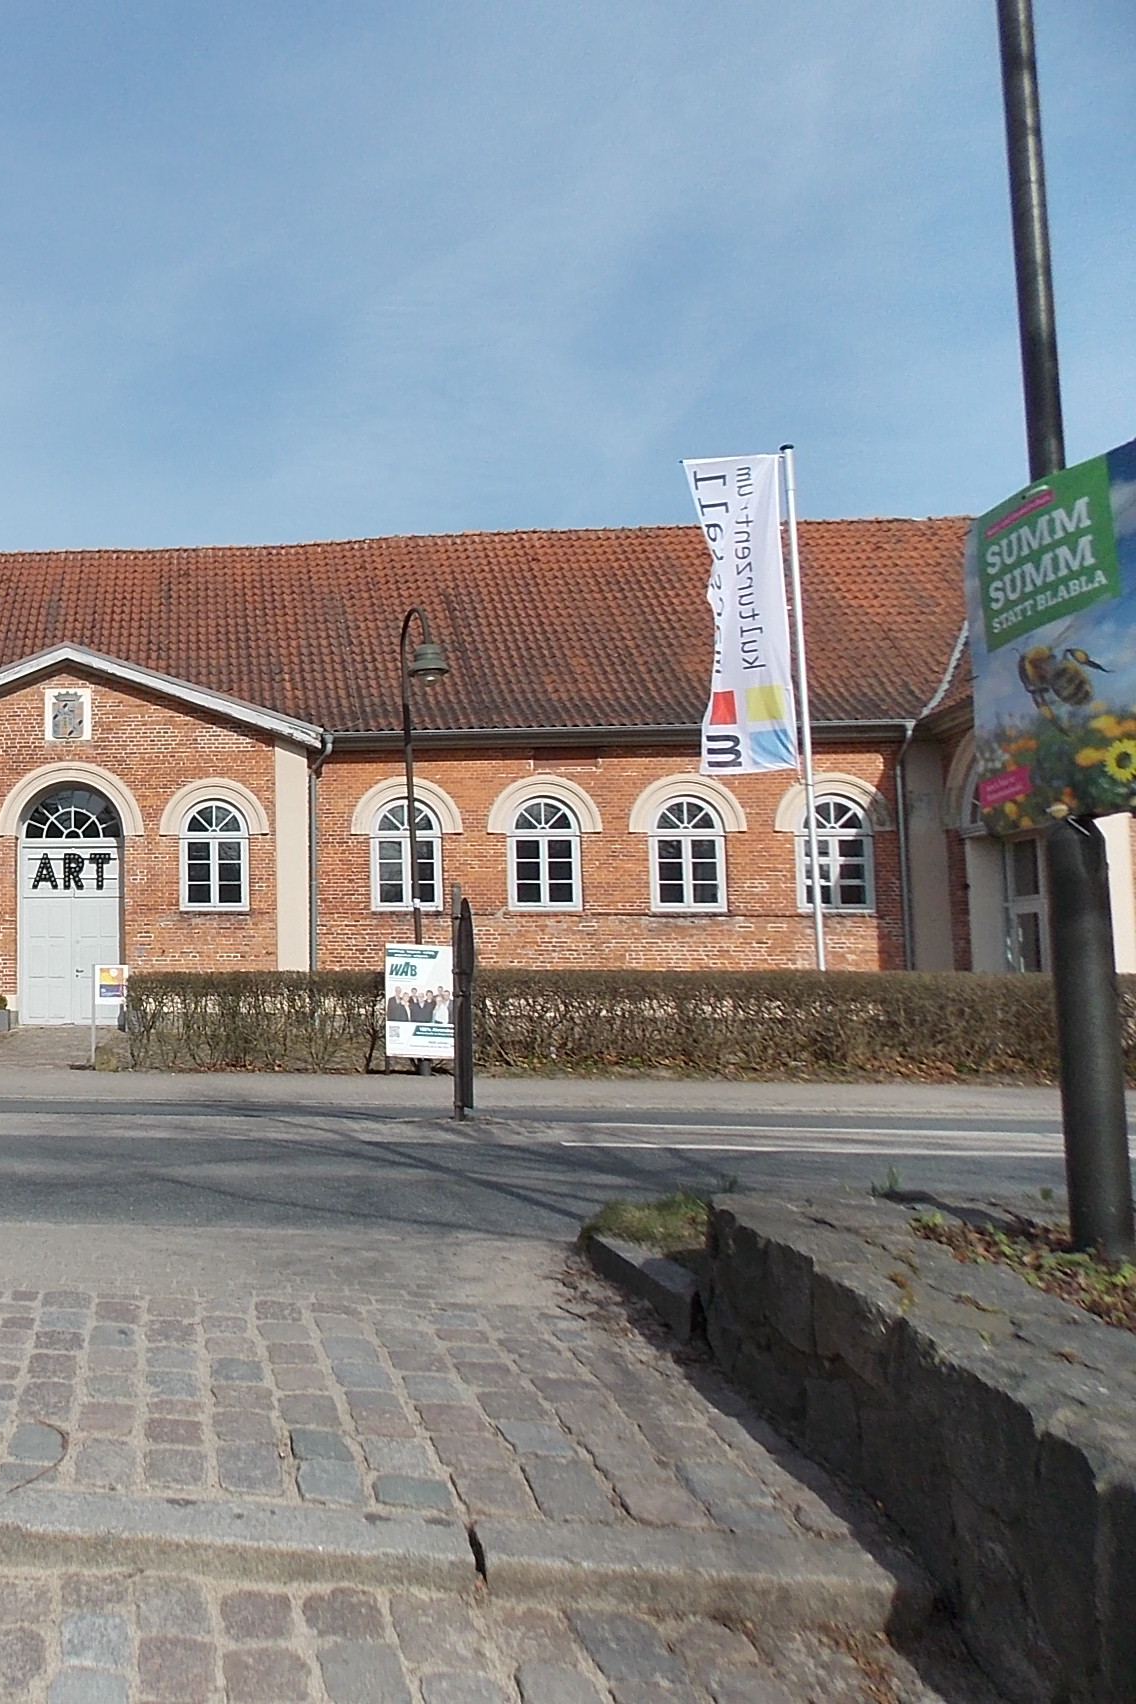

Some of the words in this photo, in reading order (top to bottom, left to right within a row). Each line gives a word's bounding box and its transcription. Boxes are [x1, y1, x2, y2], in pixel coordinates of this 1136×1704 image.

[985, 496, 1092, 574] SUMM
[988, 534, 1096, 610] SUMM
[992, 599, 1034, 634] STATT
[1035, 569, 1108, 612] BLABLA
[31, 852, 112, 890] ART
